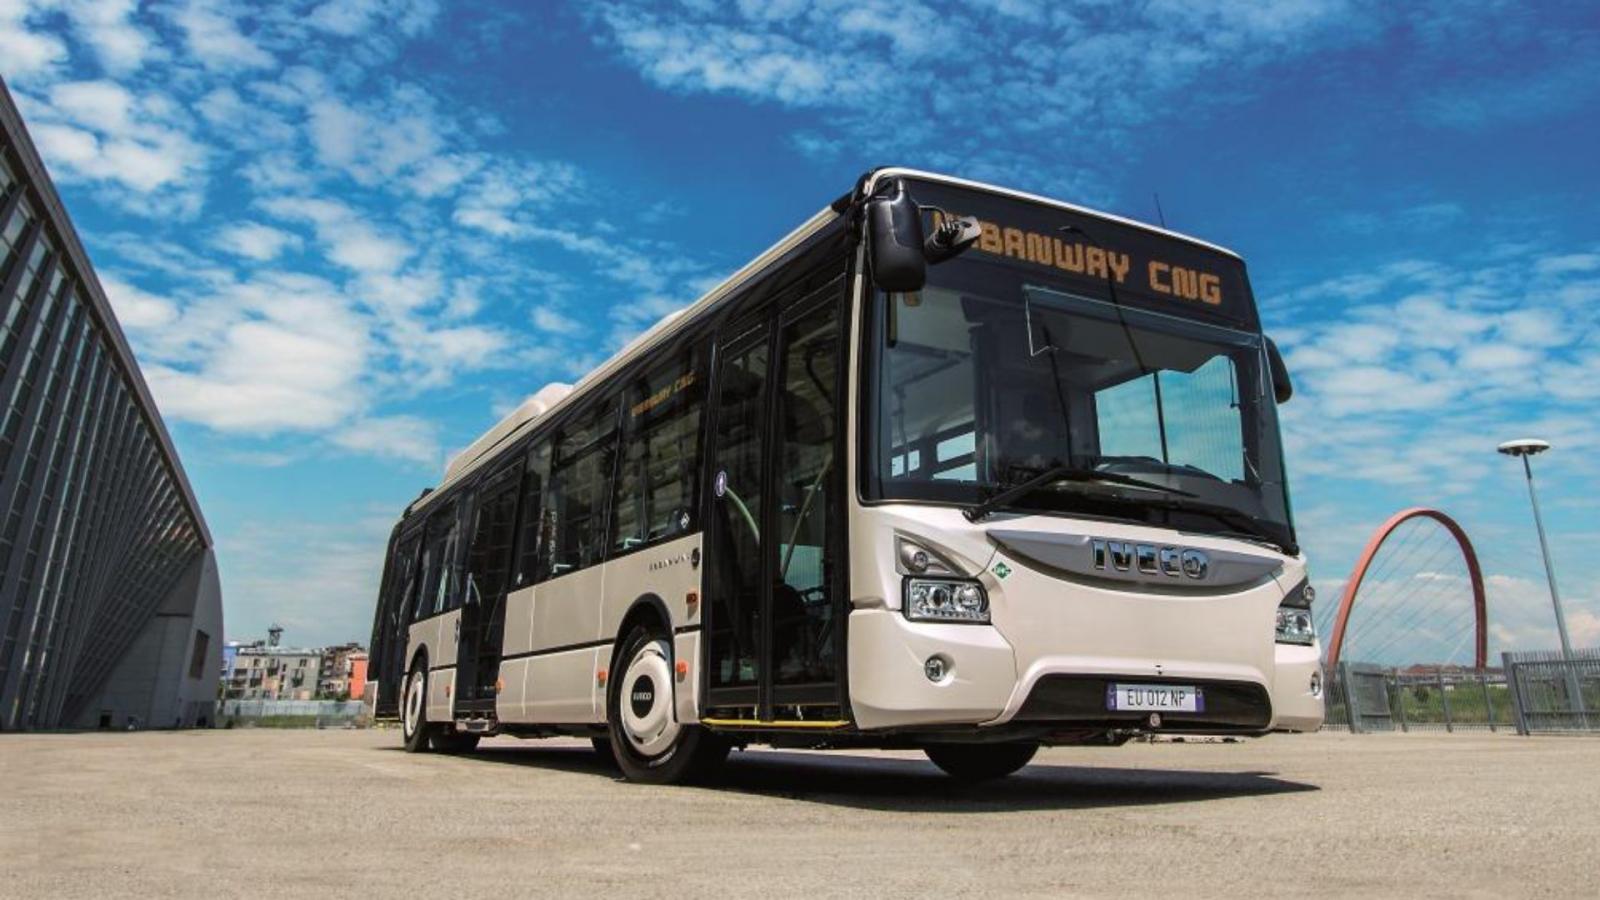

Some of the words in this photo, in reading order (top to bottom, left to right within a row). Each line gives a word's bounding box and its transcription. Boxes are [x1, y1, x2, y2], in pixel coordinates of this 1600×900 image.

[933, 210, 1130, 283] BANWAY
[1149, 260, 1221, 304] CNG
[1093, 540, 1208, 579] IVECO
[1127, 688, 1143, 706] EU
[1147, 688, 1167, 706] 012
[1171, 689, 1186, 708] NP
